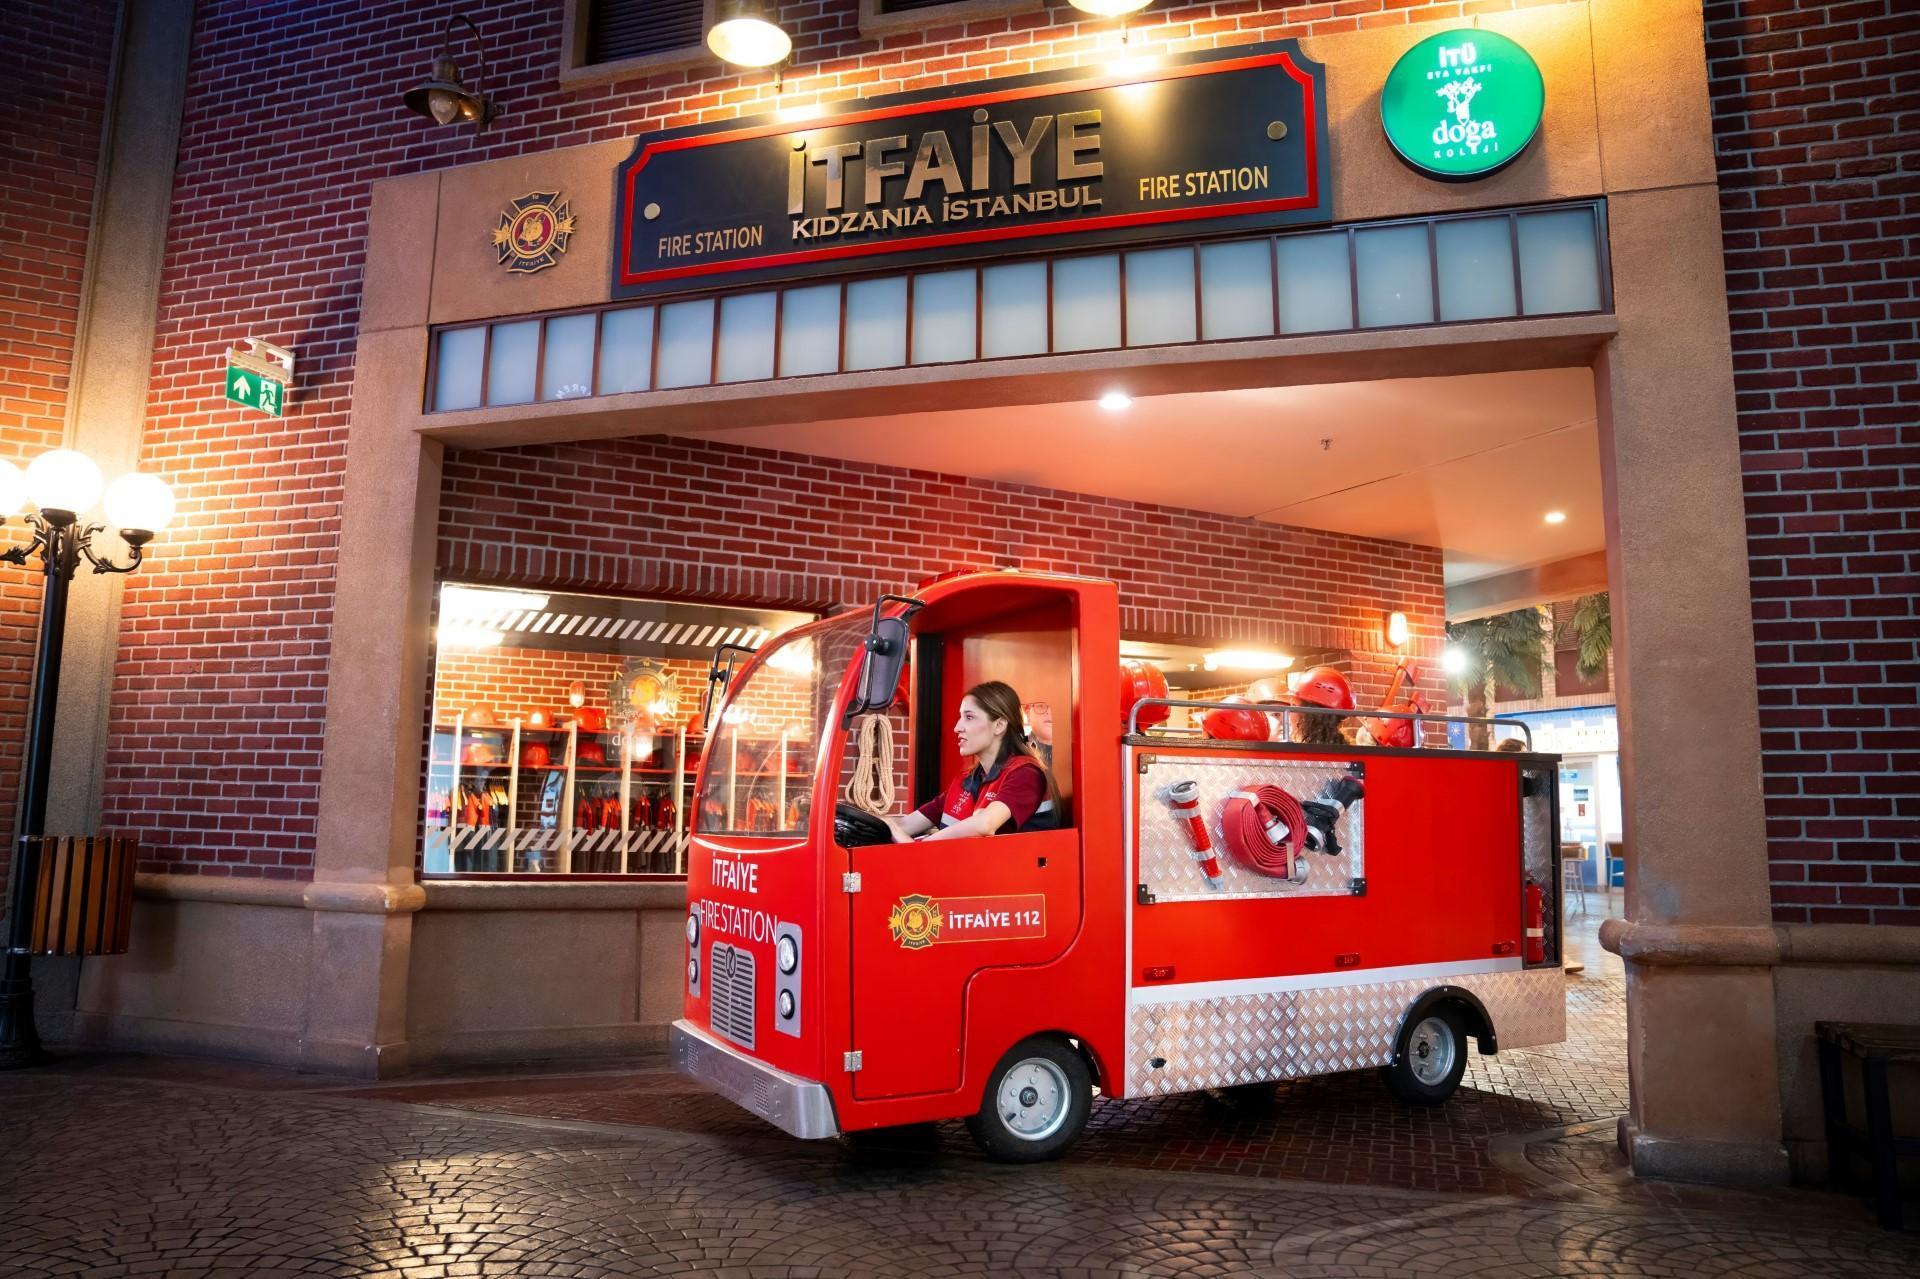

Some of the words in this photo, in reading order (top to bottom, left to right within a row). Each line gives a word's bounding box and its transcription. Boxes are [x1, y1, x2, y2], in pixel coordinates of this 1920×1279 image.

[1432, 120, 1497, 148] doğa
[787, 108, 1104, 215] İTFAİYE
[1139, 174, 1181, 201] FIRE
[1185, 165, 1268, 197] STATION
[792, 205, 935, 240] KIDZANIA
[942, 185, 1103, 222] İSTANBUL
[658, 234, 692, 258] FIRE
[695, 224, 763, 254] STATION
[712, 850, 759, 894] İTFAİYE
[700, 898, 720, 930] FIRE
[720, 903, 778, 946] STATION
[949, 909, 1011, 929] İTFAİYE
[1014, 910, 1041, 926] 112
